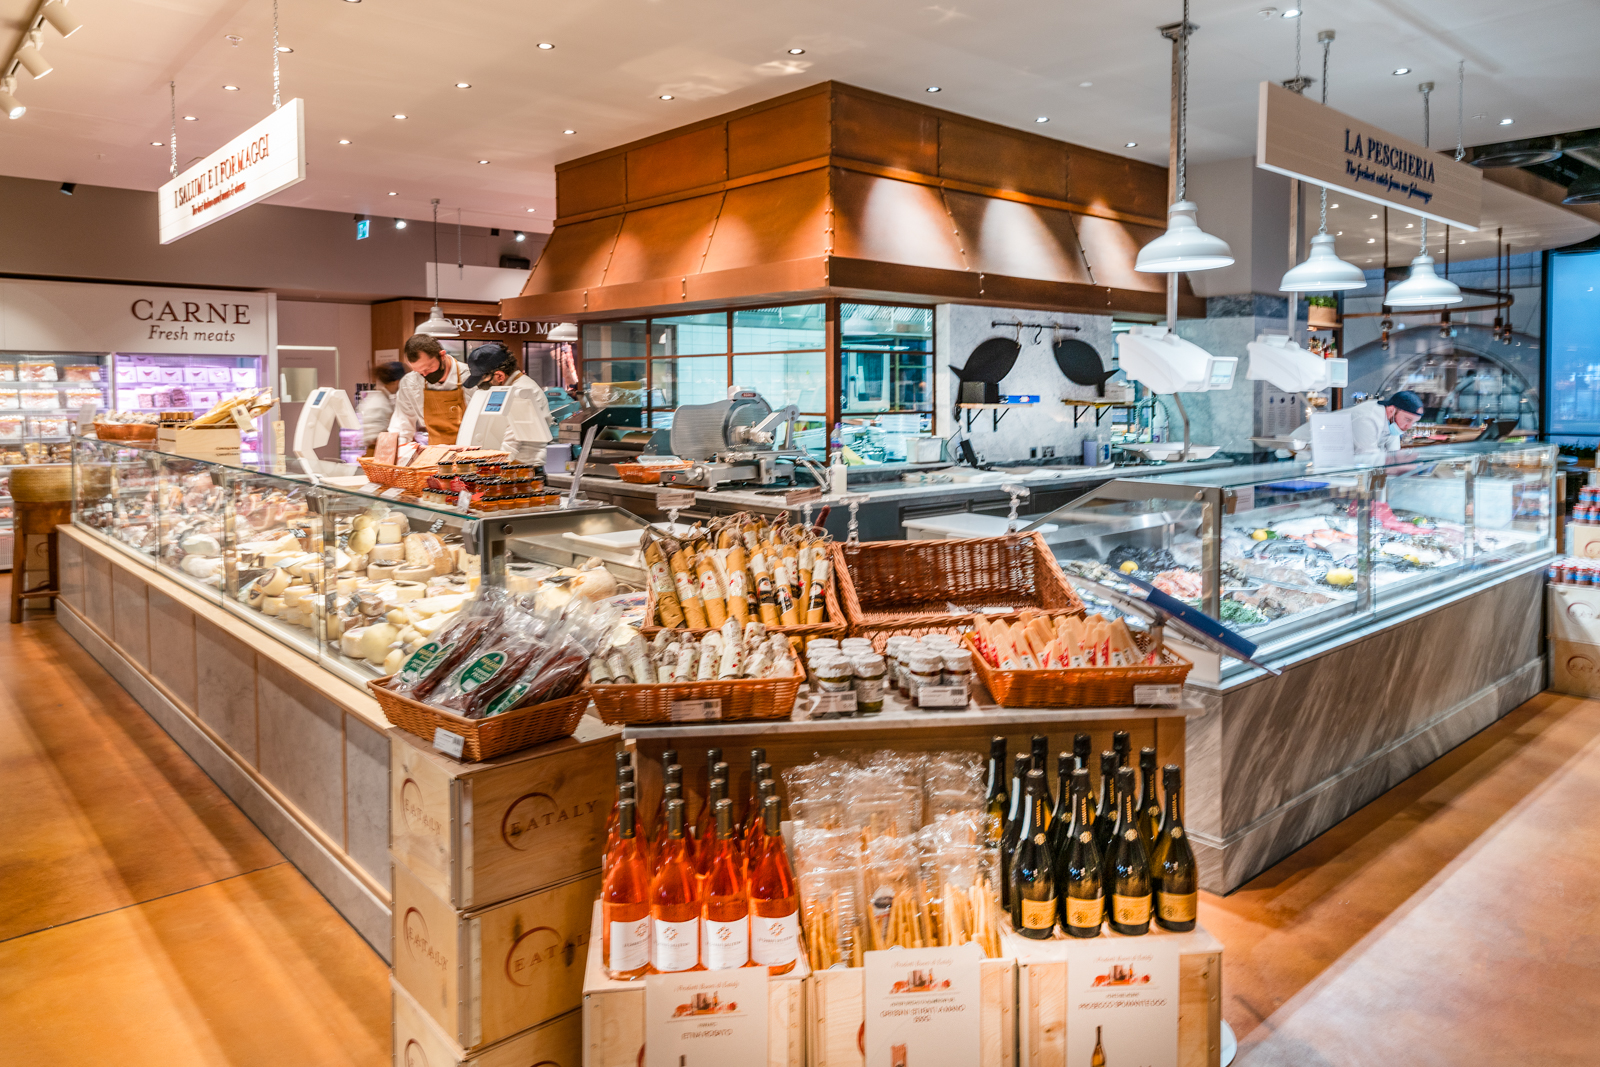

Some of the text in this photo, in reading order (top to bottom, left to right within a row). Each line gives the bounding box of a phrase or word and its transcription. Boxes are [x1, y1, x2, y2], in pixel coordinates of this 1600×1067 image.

[174, 133, 269, 209] I SALUMI E I FORMAGGI
[1344, 128, 1435, 184] LA PESCHERIA
[1345, 158, 1357, 177] The
[131, 299, 251, 325] CARNE
[147, 324, 236, 342] Fresh meats
[405, 798, 443, 836] EATALY
[510, 800, 599, 836] EATALY
[409, 926, 449, 971] EATALY
